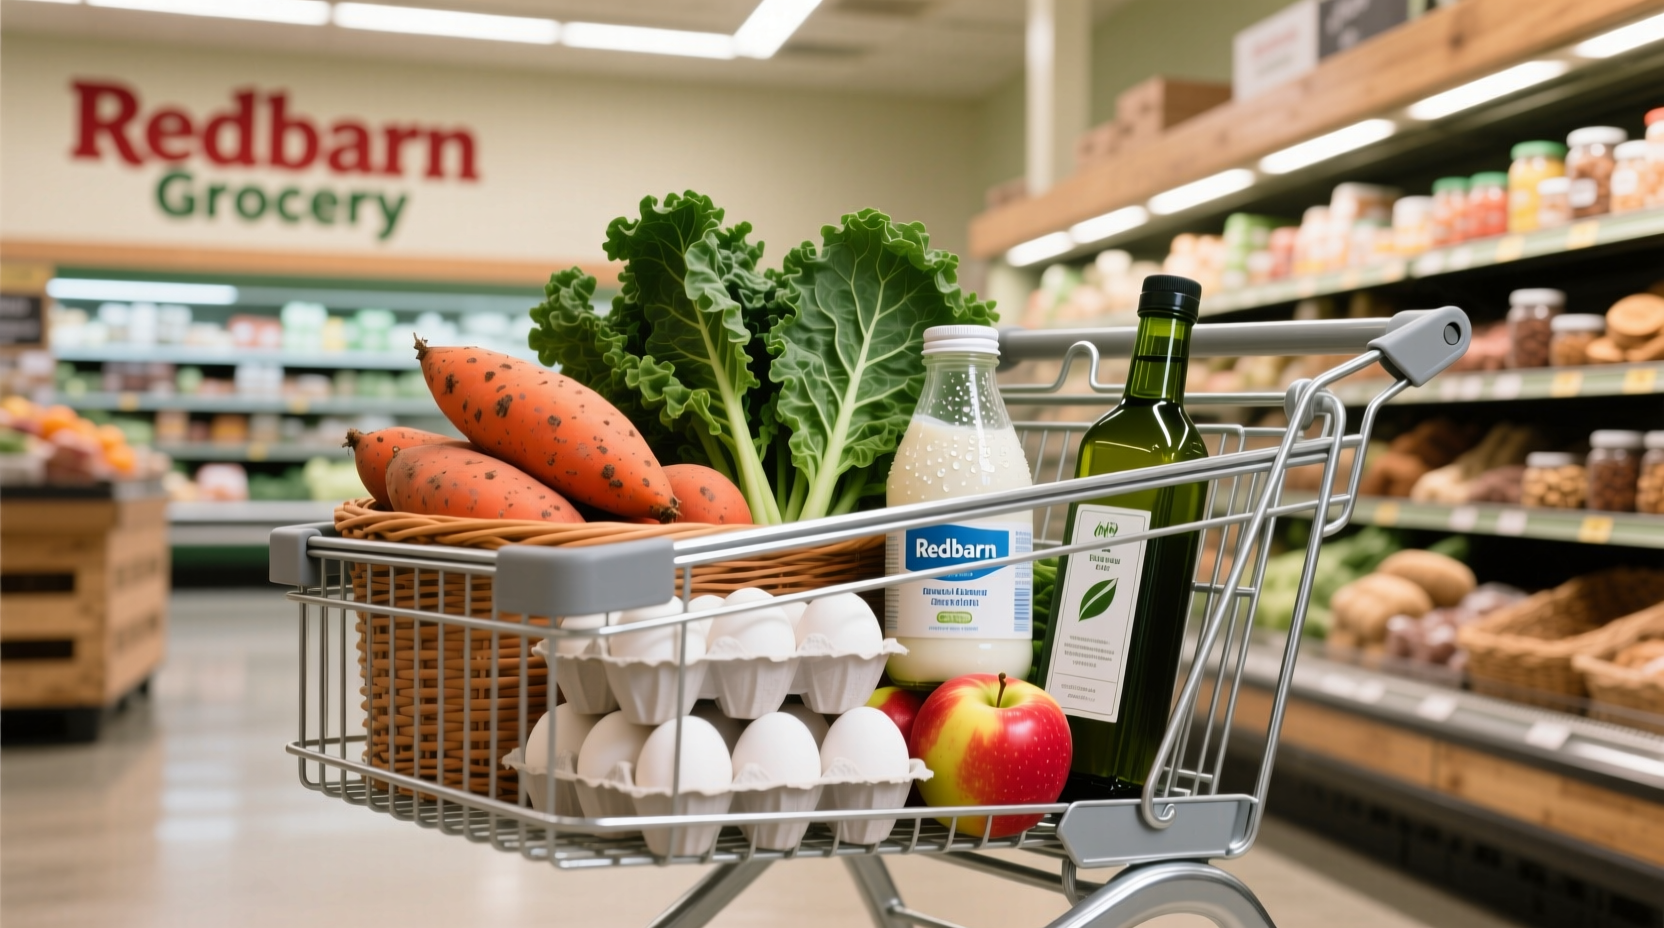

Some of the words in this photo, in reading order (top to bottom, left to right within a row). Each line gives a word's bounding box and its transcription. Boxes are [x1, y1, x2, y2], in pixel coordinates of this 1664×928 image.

[72, 81, 478, 181] Redbarn
[156, 171, 407, 239] Grocery
[916, 538, 997, 558] Redbarn
